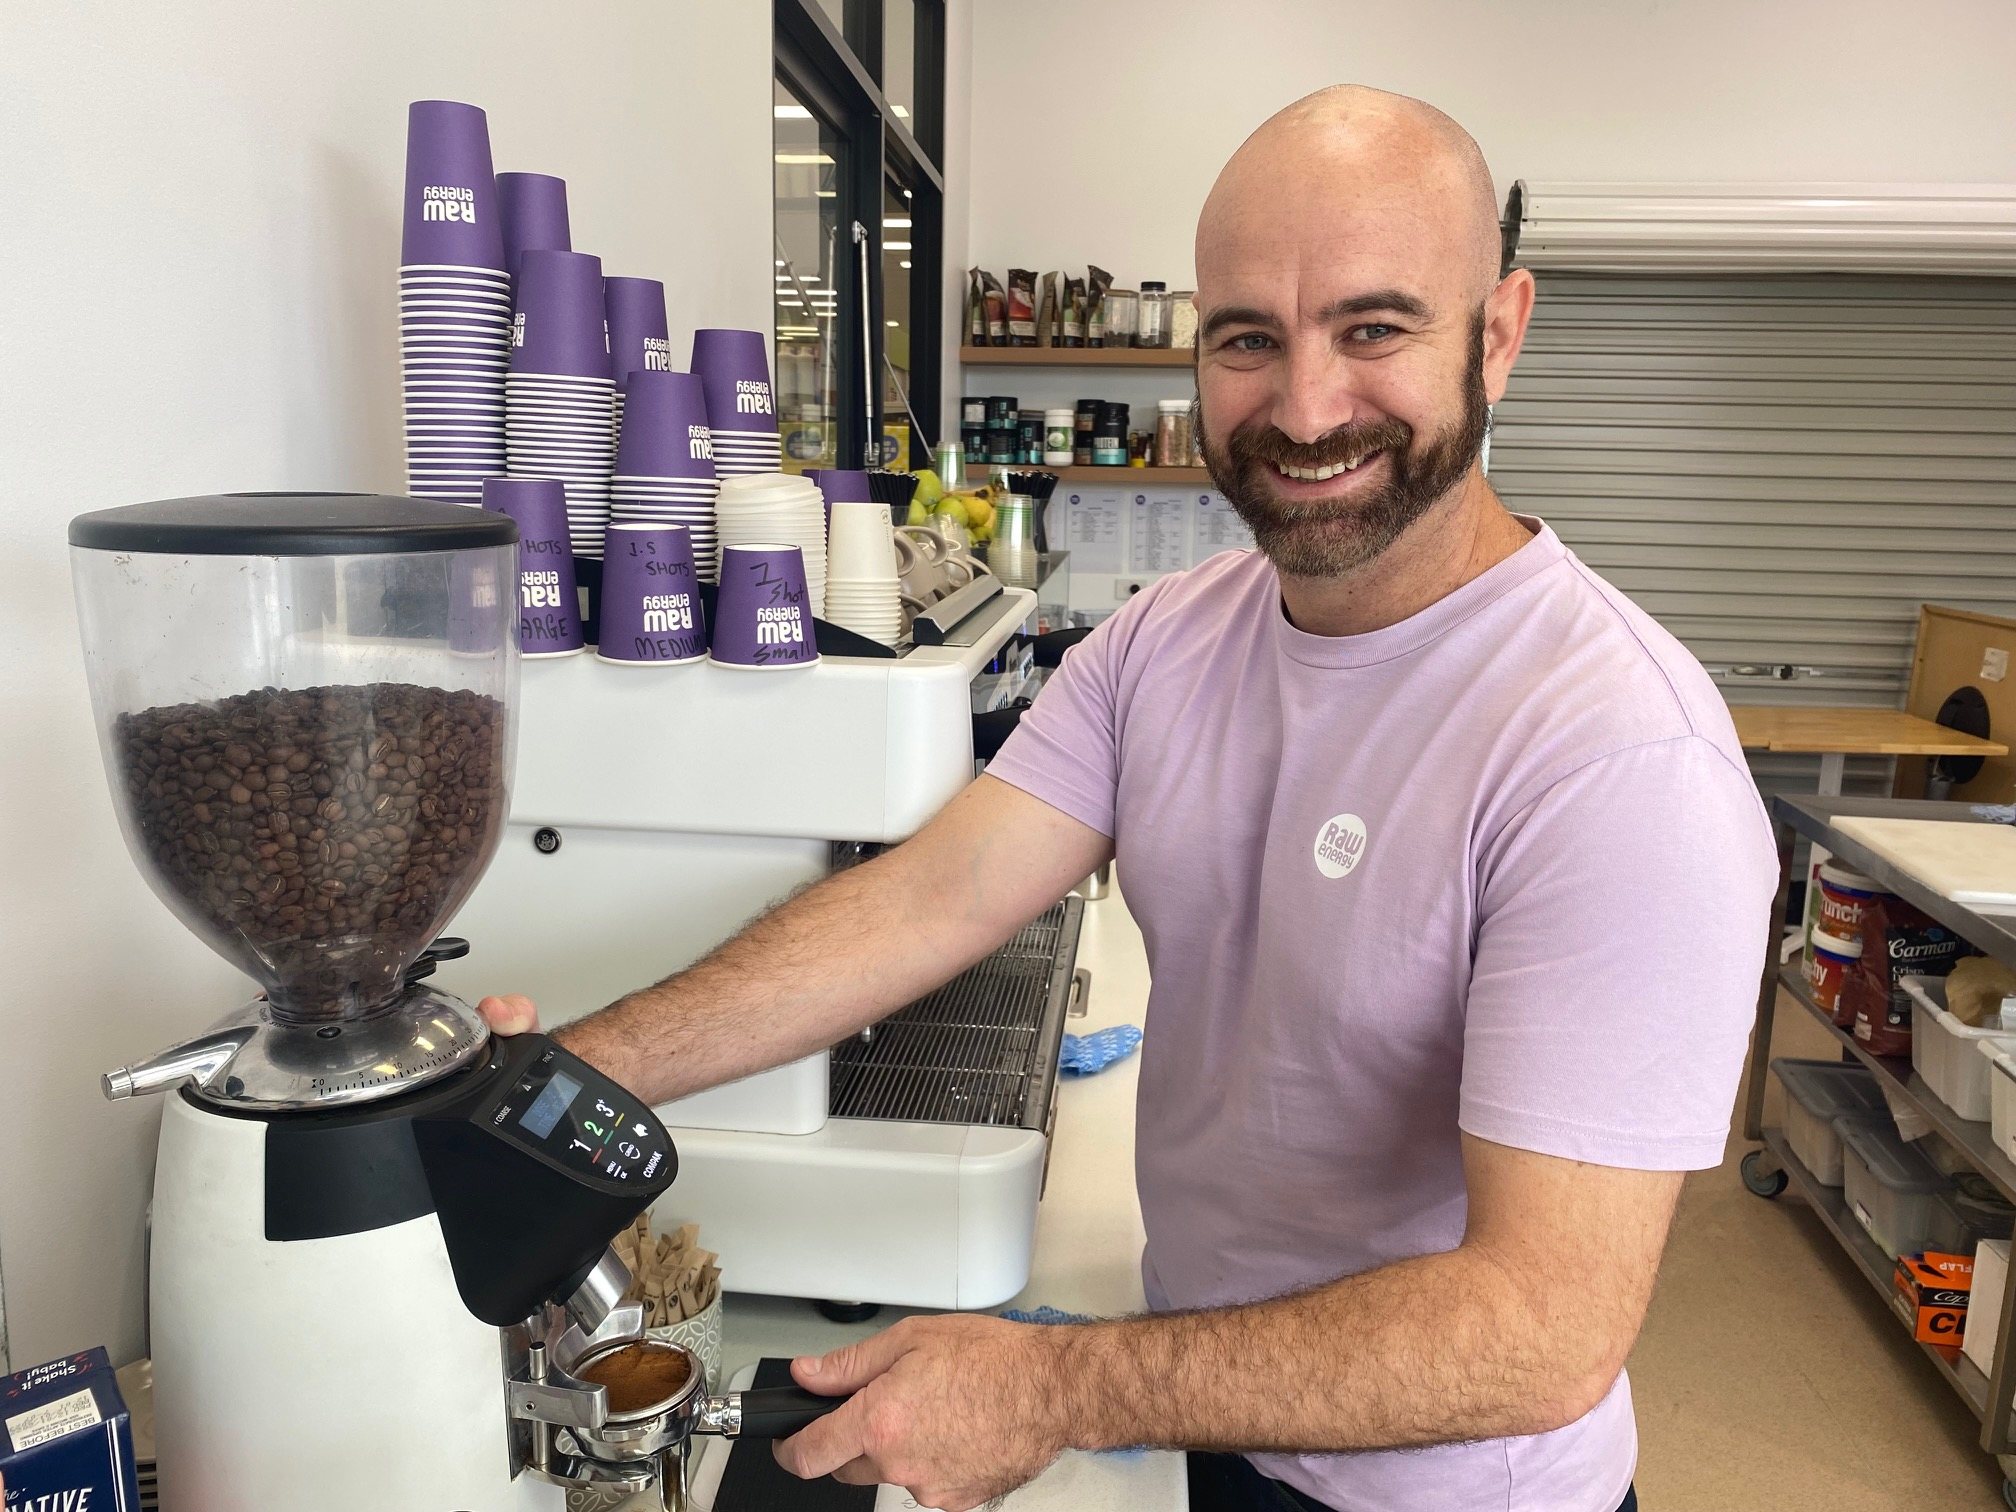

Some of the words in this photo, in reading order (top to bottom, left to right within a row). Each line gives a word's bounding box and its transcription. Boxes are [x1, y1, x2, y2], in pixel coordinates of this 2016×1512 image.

[423, 200, 476, 224] Raw
[520, 539, 562, 555] HOTS
[645, 561, 690, 577] SHOTS
[644, 607, 693, 632] Raw
[757, 620, 803, 644] Raw
[1323, 822, 1364, 855] Raw
[584, 1120, 604, 1136] 2
[643, 1151, 663, 1178] COMPAK
[26, 1360, 67, 1381] baby!
[35, 1365, 76, 1385] Shake
[21, 1381, 33, 1391] it
[67, 1416, 96, 1431] BEST
[19, 1428, 64, 1448] BEFORE
